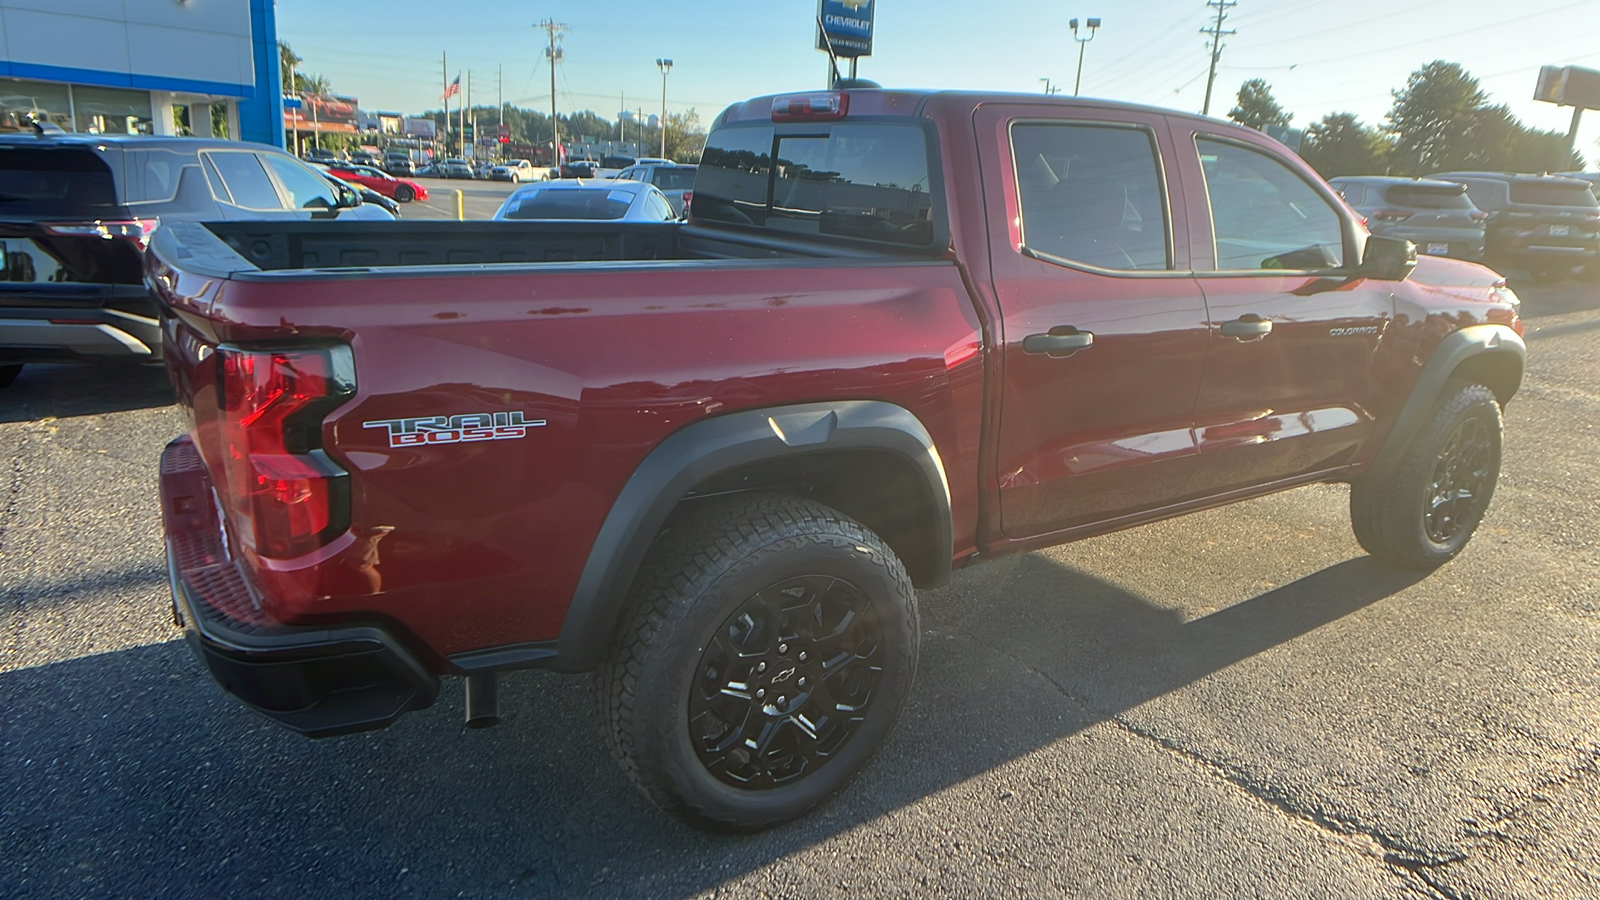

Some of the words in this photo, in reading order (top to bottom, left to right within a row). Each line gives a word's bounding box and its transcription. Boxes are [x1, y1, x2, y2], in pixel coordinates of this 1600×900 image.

[826, 14, 870, 31] CHEVROLET
[1330, 326, 1378, 336] COLORADO
[363, 411, 546, 434] TRAIL
[390, 425, 526, 448] BOSS
